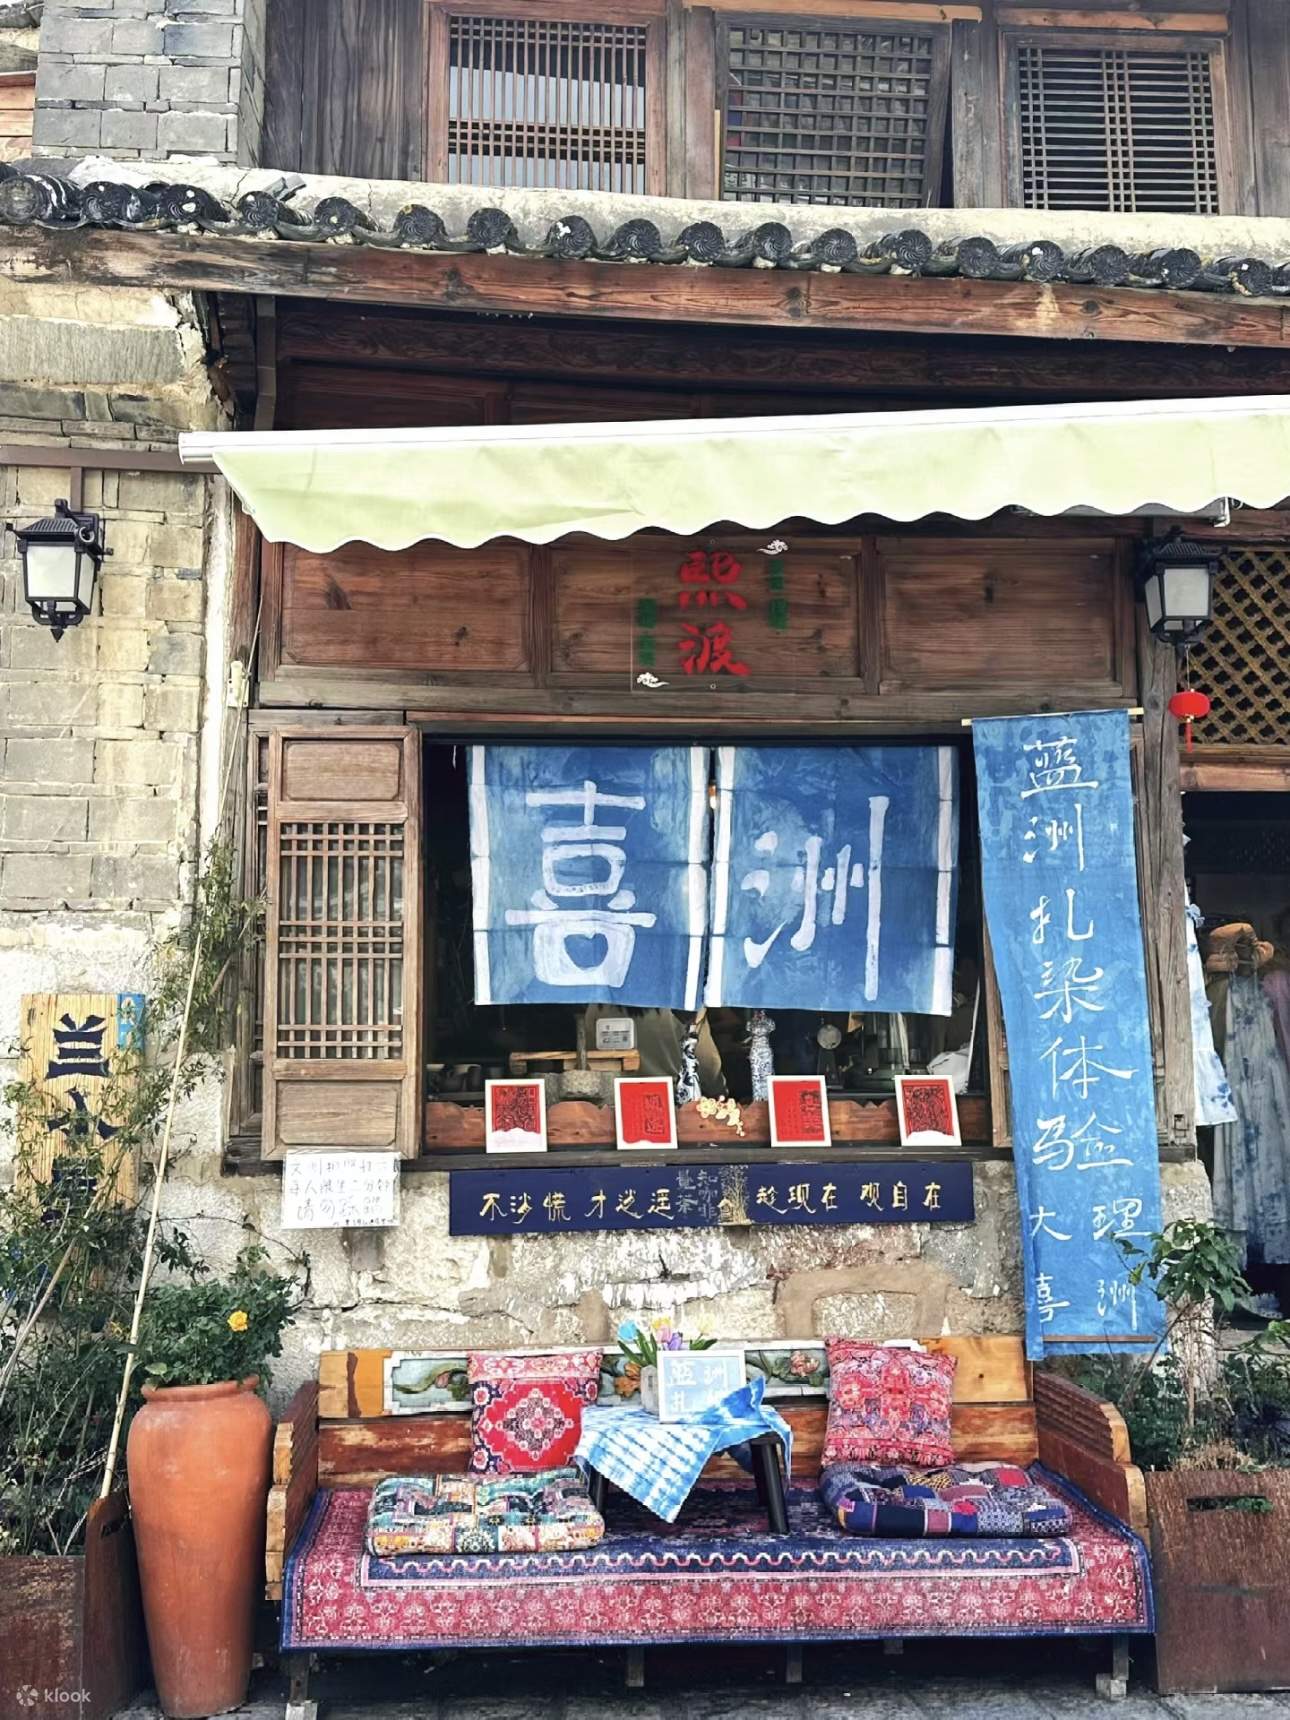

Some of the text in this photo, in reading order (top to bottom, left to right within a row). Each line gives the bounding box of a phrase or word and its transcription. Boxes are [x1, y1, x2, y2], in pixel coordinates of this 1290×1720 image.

[505, 780, 889, 1001] 喜洲
[860, 1180, 942, 1212] 观自在
